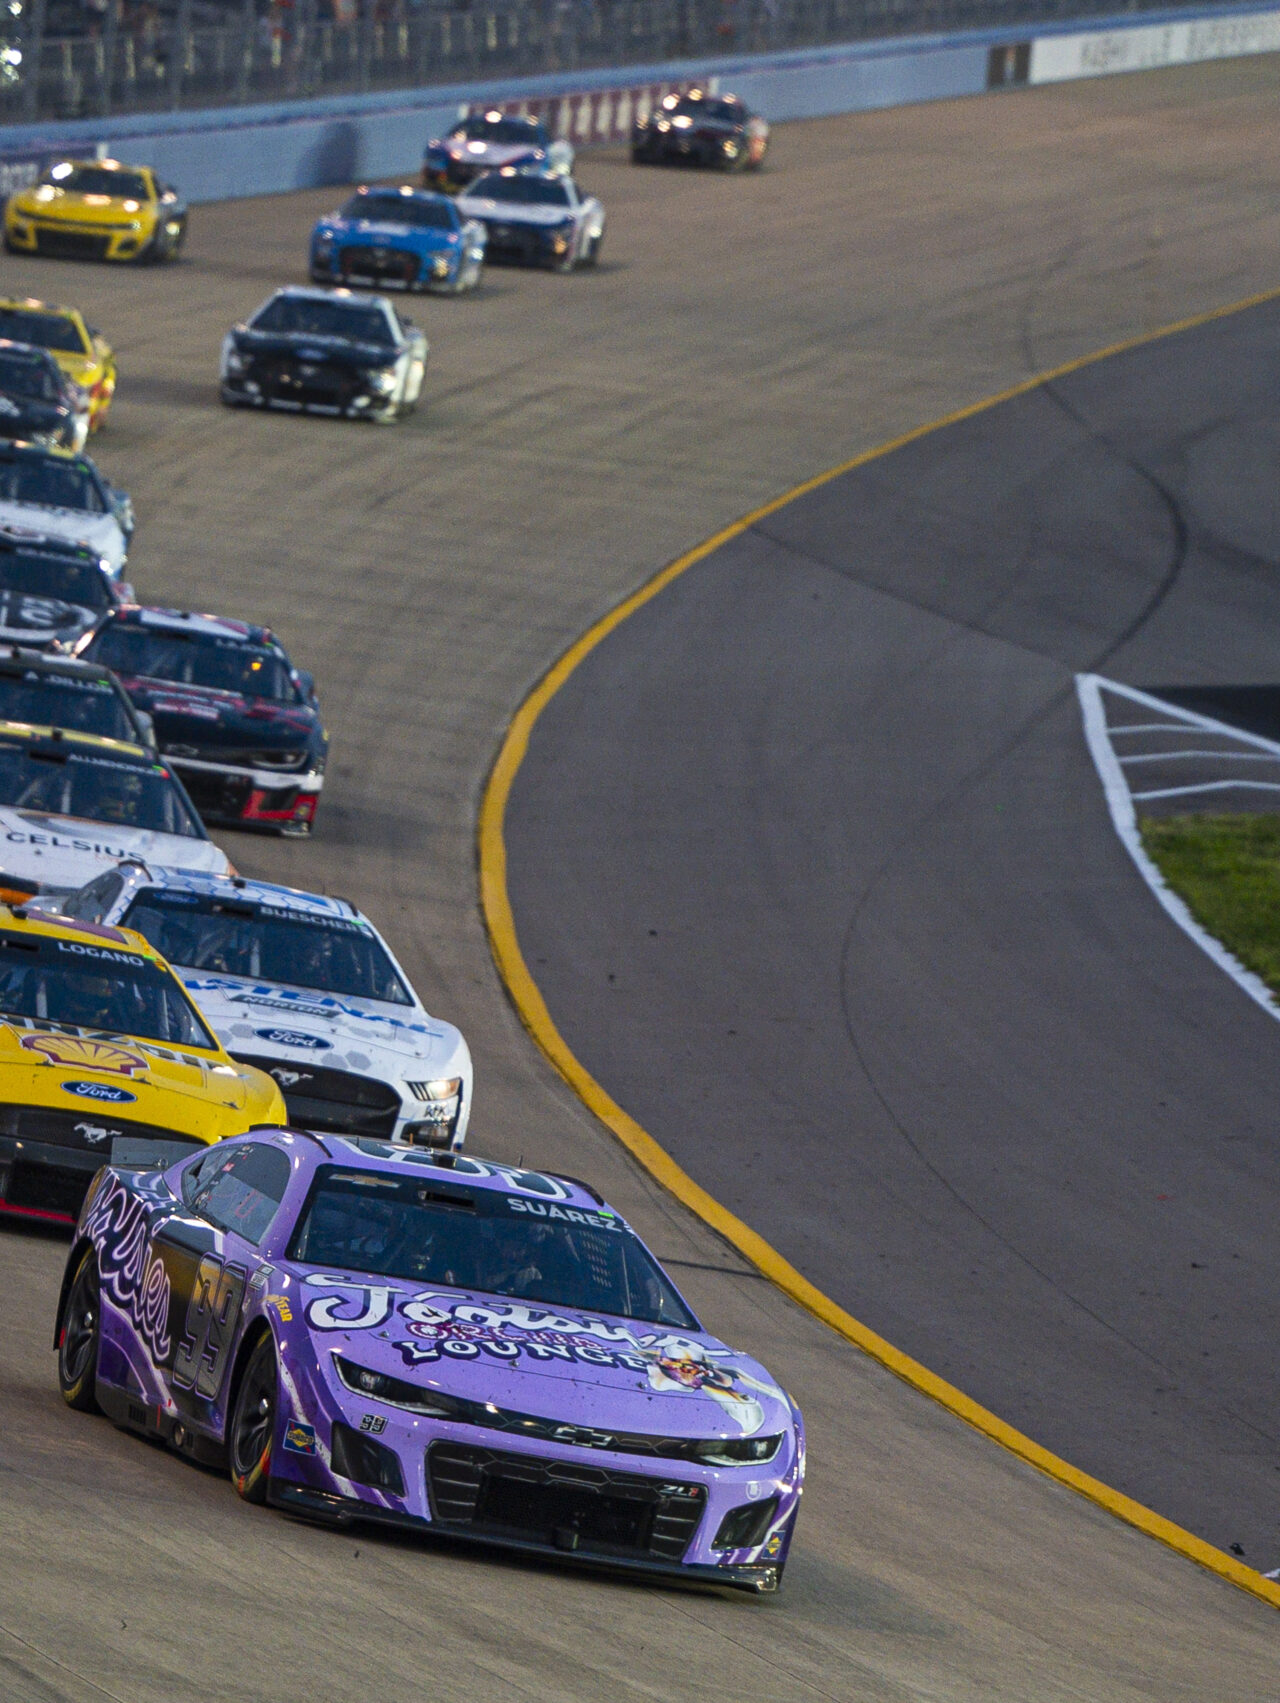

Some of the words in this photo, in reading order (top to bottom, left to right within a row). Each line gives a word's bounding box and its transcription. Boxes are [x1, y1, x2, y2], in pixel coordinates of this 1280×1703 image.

[5, 830, 145, 863] CELSIUS
[259, 904, 359, 934] BUESCHER
[58, 941, 145, 967] LOGANO
[243, 995, 329, 1017] NORTON
[269, 1030, 317, 1049] Ford
[74, 1082, 123, 1101] Ford
[506, 1197, 623, 1233] SUÁREZ
[172, 1251, 249, 1401] 99
[400, 1338, 656, 1374] LOUNGE
[359, 1413, 389, 1435] 99
